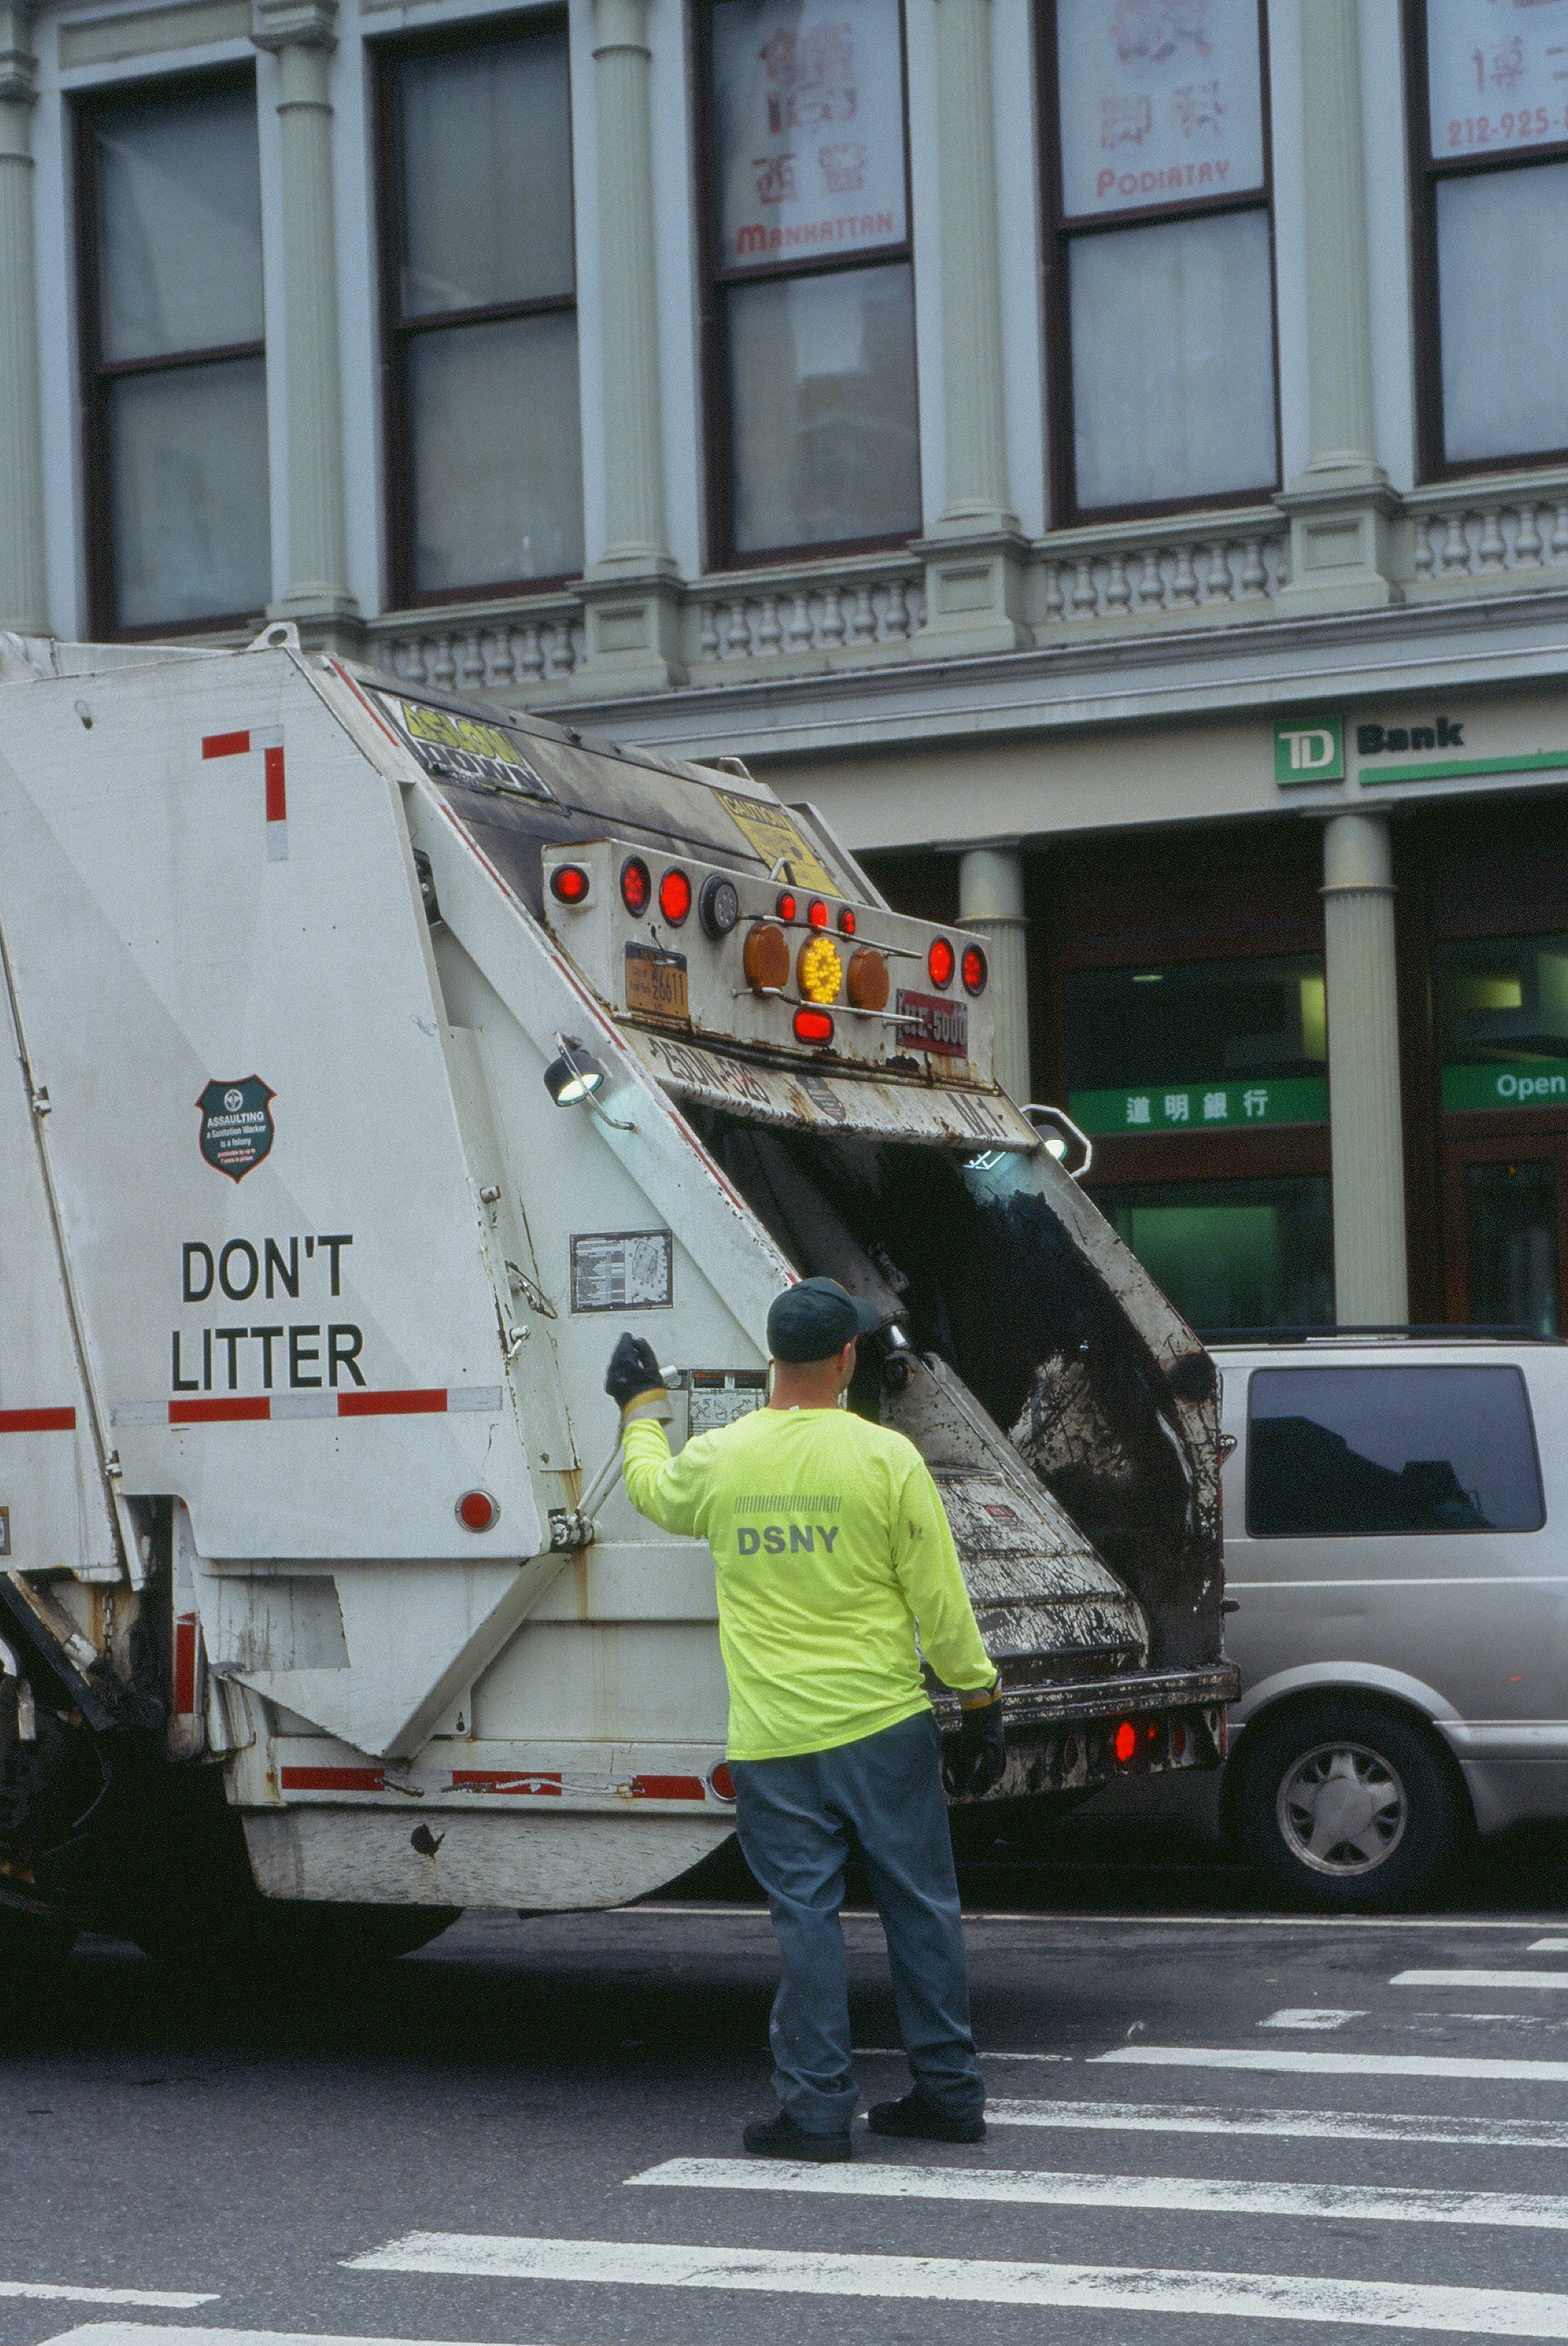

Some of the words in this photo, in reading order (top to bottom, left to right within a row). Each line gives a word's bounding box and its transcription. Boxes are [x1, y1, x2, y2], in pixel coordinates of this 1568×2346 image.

[1448, 104, 1568, 147] 212-925-
[736, 212, 894, 254] MANHATTAN
[417, 707, 525, 767] SLOW
[1278, 729, 1335, 770] TD
[1356, 716, 1465, 755] Bank
[415, 739, 547, 792] DOWN
[723, 795, 790, 830] CAUTION
[1497, 1074, 1566, 1101] Open
[207, 1112, 265, 1128] ASSAULTING
[211, 1128, 242, 1138] Sanitation
[242, 1125, 266, 1134] Worker
[182, 1234, 354, 1303] DON'T
[171, 1324, 367, 1391] LITTER
[737, 1524, 840, 1555] DSNY
